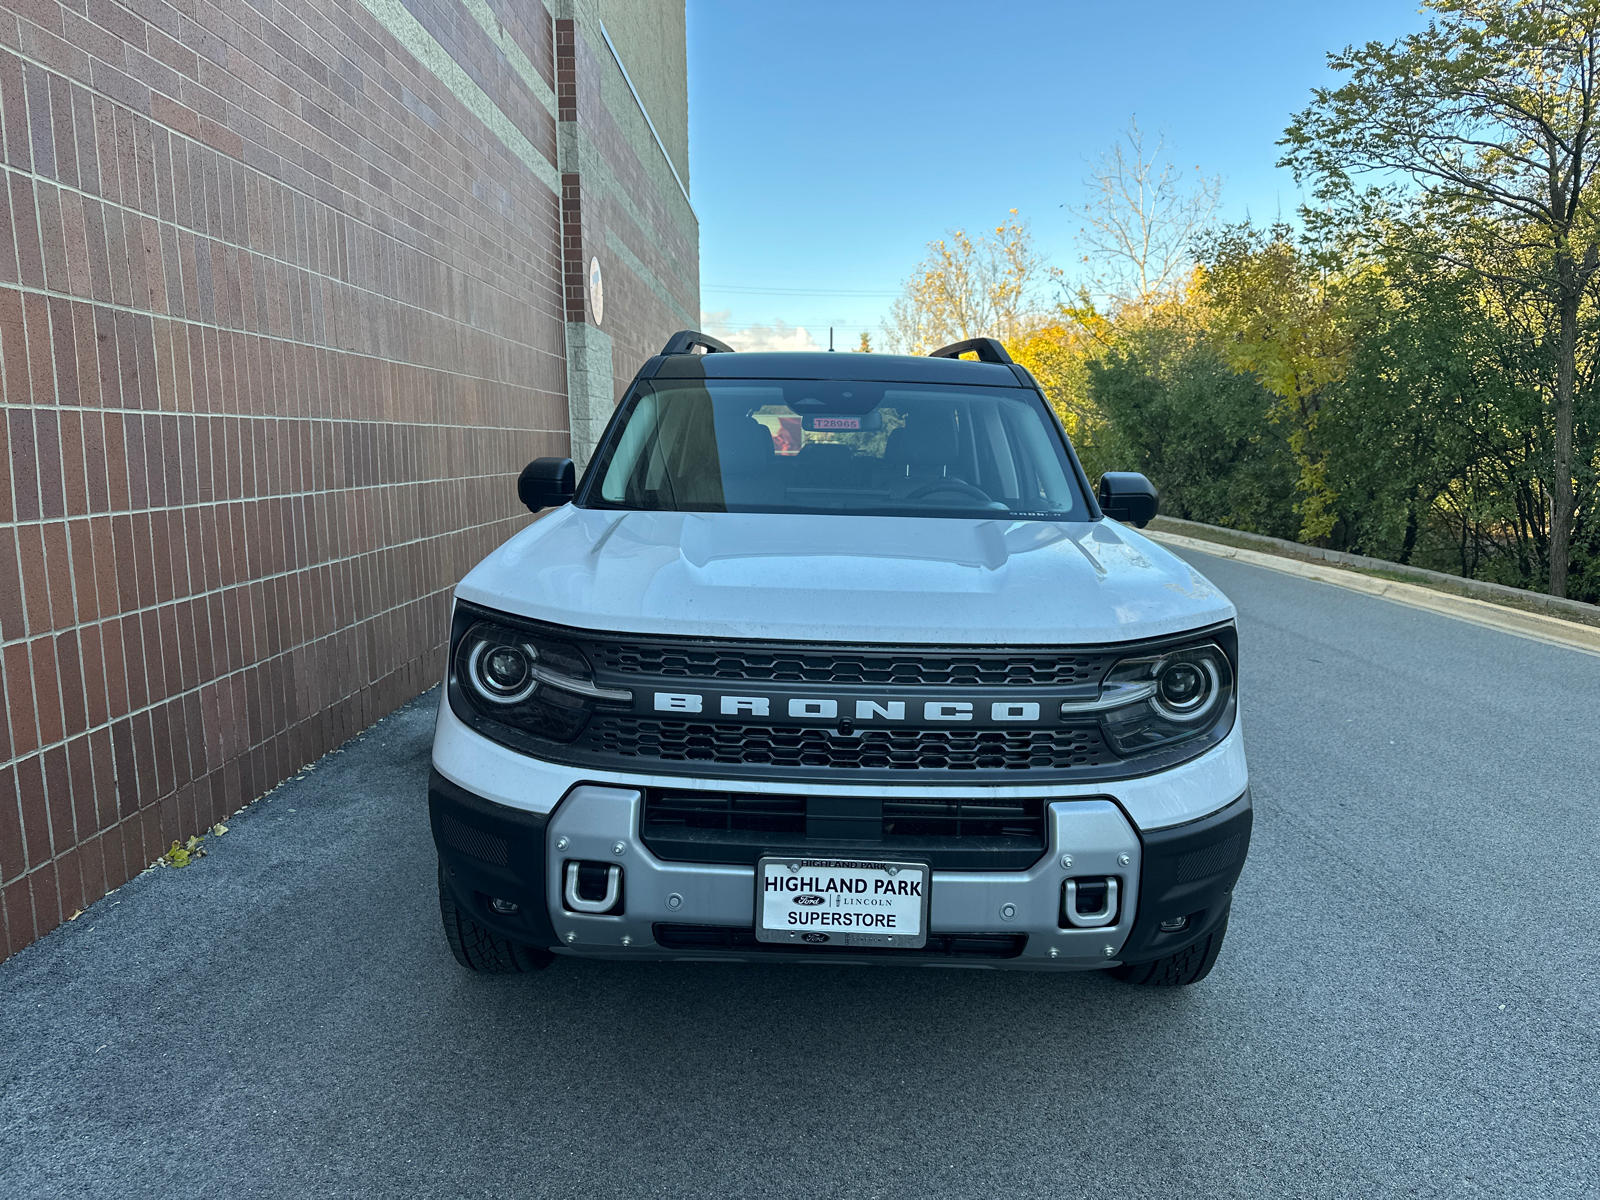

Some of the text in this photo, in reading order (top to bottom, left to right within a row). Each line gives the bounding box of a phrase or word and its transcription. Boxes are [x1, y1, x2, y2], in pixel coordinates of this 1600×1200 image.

[815, 419, 857, 428] T28965
[654, 692, 1040, 721] BRONCO
[801, 860, 887, 870] HIGHLAND PARK
[764, 876, 922, 897] HIGHLAND PARK
[797, 895, 893, 907] Ford LINCOLN
[787, 911, 897, 928] SUPERSTORE
[805, 933, 826, 942] Ford
